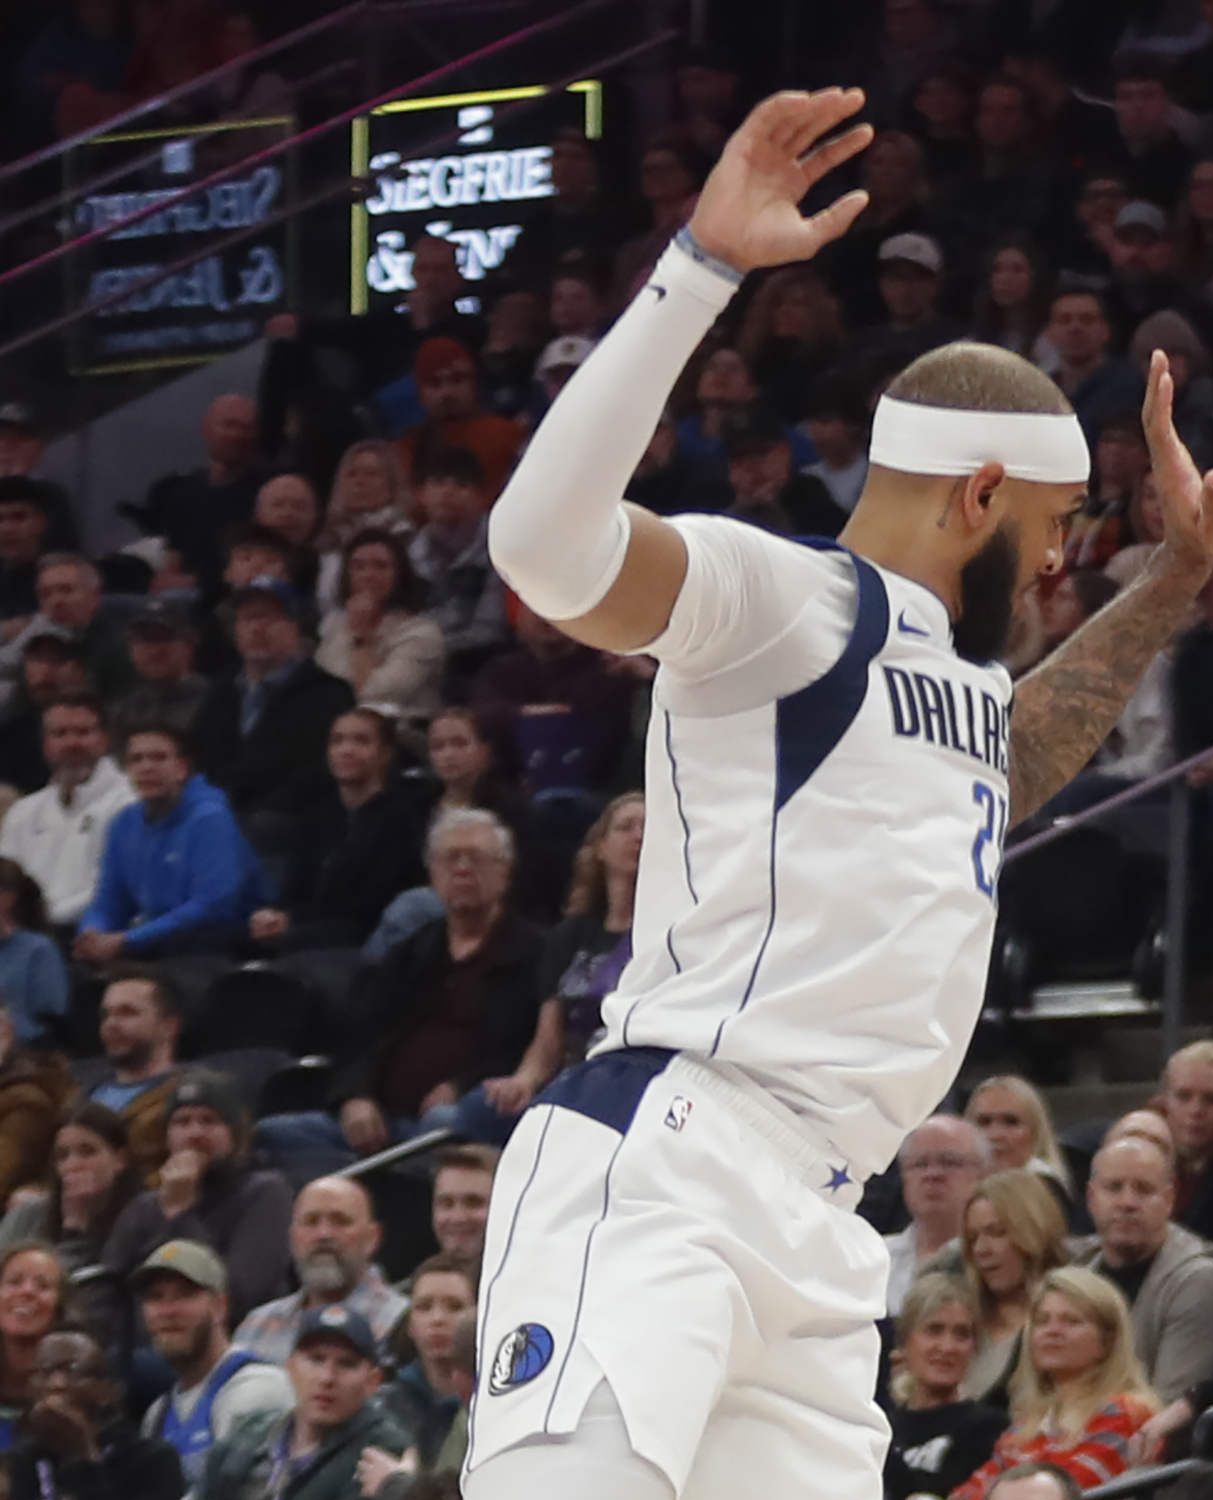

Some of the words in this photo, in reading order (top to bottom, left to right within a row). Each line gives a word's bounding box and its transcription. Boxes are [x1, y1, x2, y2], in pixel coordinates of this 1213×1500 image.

[366, 146, 558, 215] SIEGFRIE
[366, 230, 417, 292] &
[883, 665, 1009, 776] DALLAS
